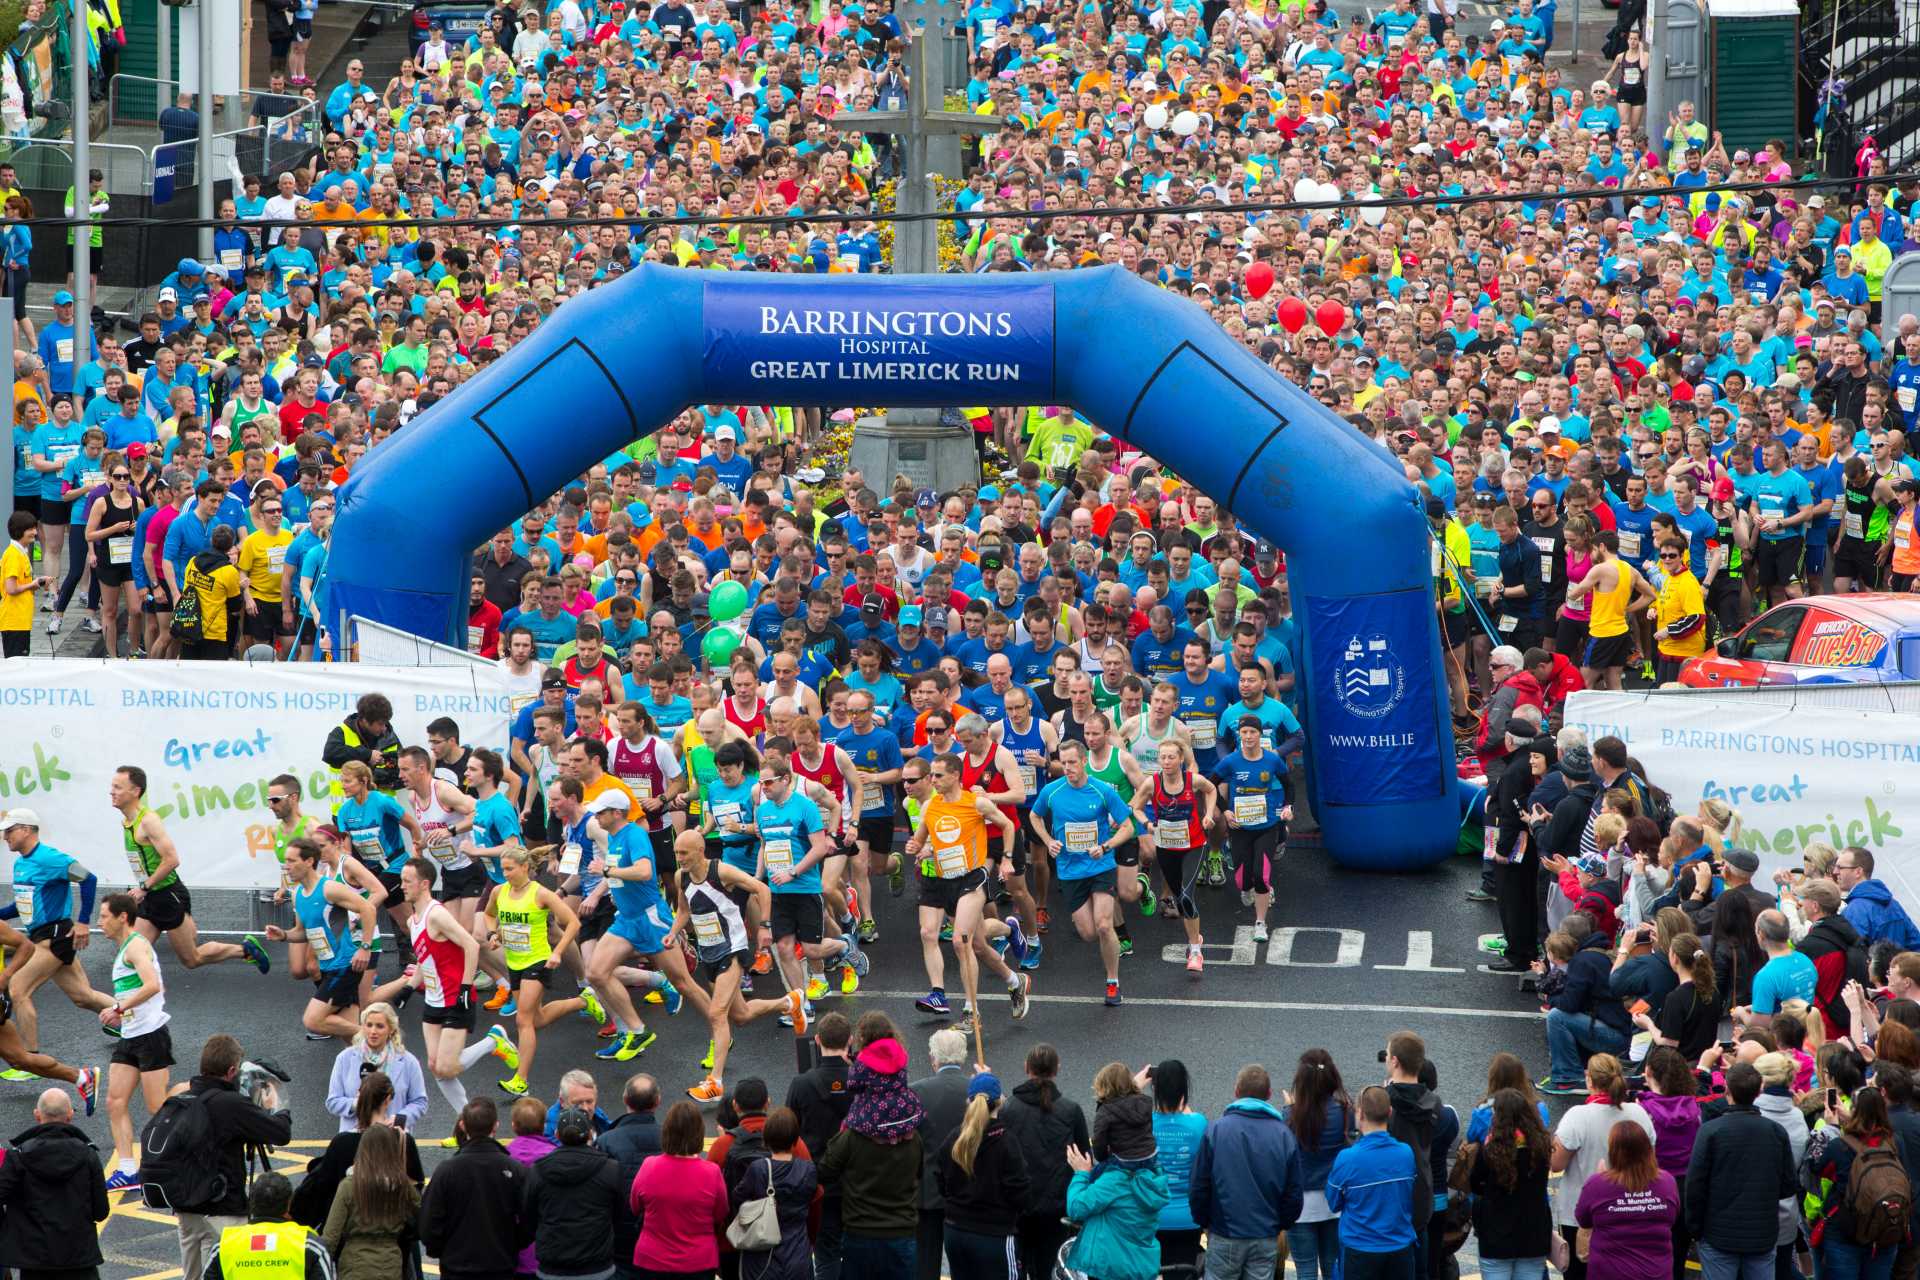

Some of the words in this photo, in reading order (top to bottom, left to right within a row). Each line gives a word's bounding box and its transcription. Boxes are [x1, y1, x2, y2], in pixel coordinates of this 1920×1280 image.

[155, 165, 175, 178] URINALS
[760, 306, 1012, 337] BARRINGTONS
[840, 338, 931, 355] HOSPITAL
[750, 361, 831, 379] GREAT
[839, 362, 960, 381] LIMERICK
[968, 363, 1020, 381] RUN
[122, 690, 278, 709] BARRINGTONS
[284, 692, 363, 711] HOSPIT
[1344, 701, 1394, 716] BARRINGTONS
[164, 727, 272, 771] Great
[1329, 733, 1415, 748] WWW.BHL.IE
[1662, 728, 1814, 756] BARRINGTONS
[1703, 774, 1809, 806] Great
[235, 1260, 262, 1268] VIDEO
[265, 1259, 290, 1267] CREW
